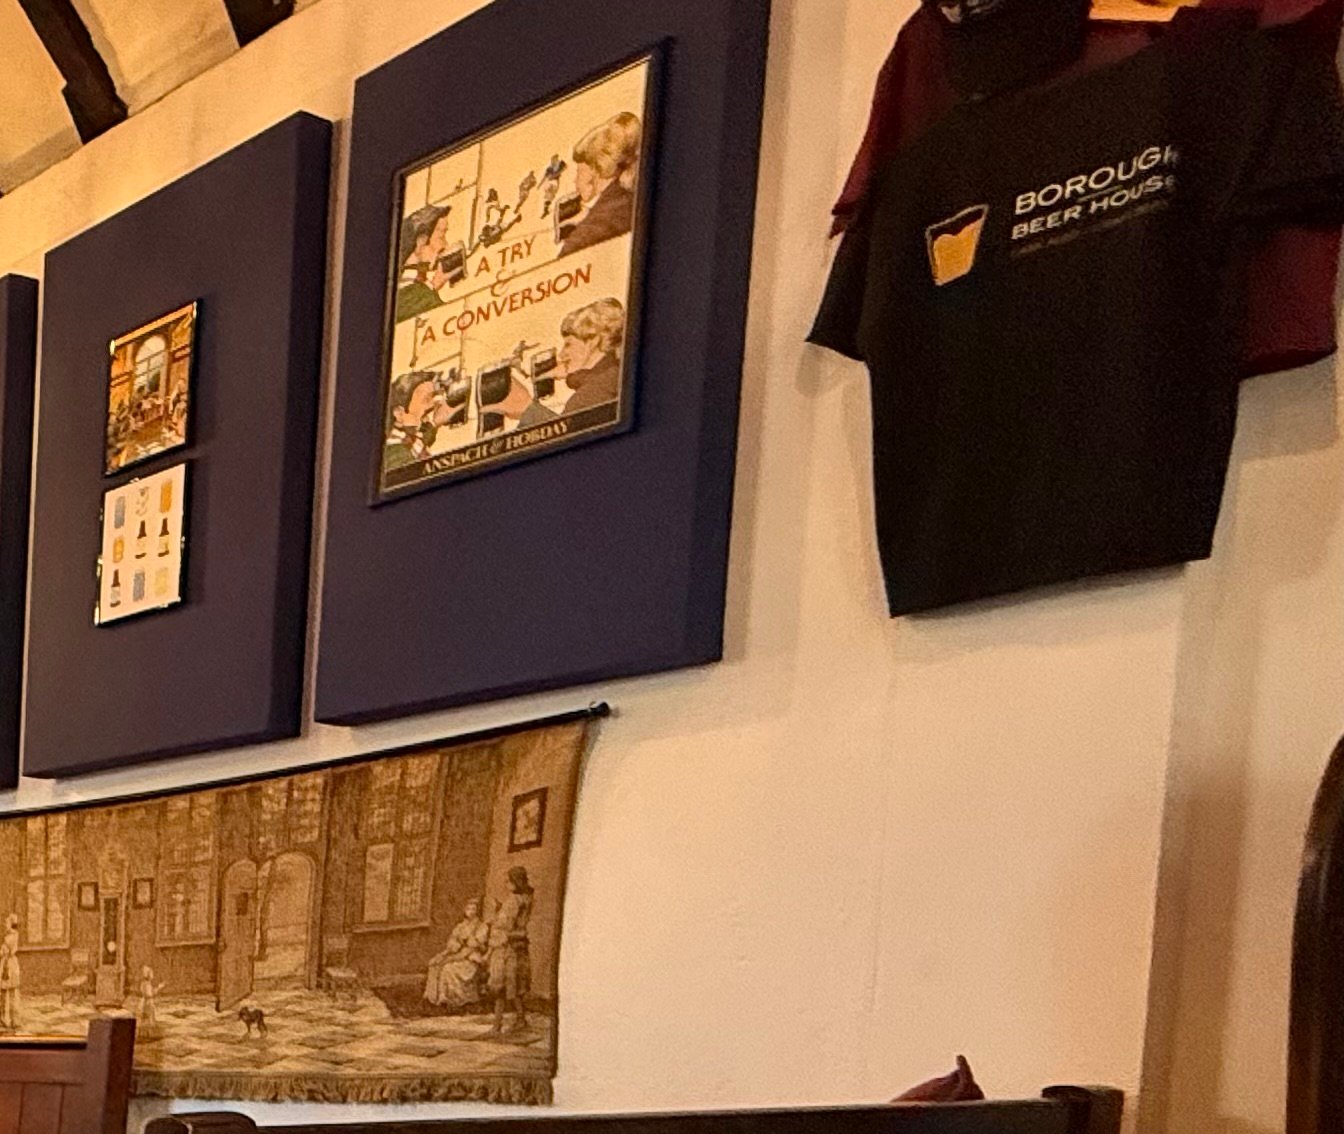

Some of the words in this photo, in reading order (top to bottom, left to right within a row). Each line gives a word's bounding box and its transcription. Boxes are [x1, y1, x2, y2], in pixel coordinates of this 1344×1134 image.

[1012, 205, 1082, 240] BEER
[474, 256, 491, 277] A
[498, 236, 536, 267] TRY
[421, 326, 436, 346] A
[443, 264, 592, 336] CONVERSION
